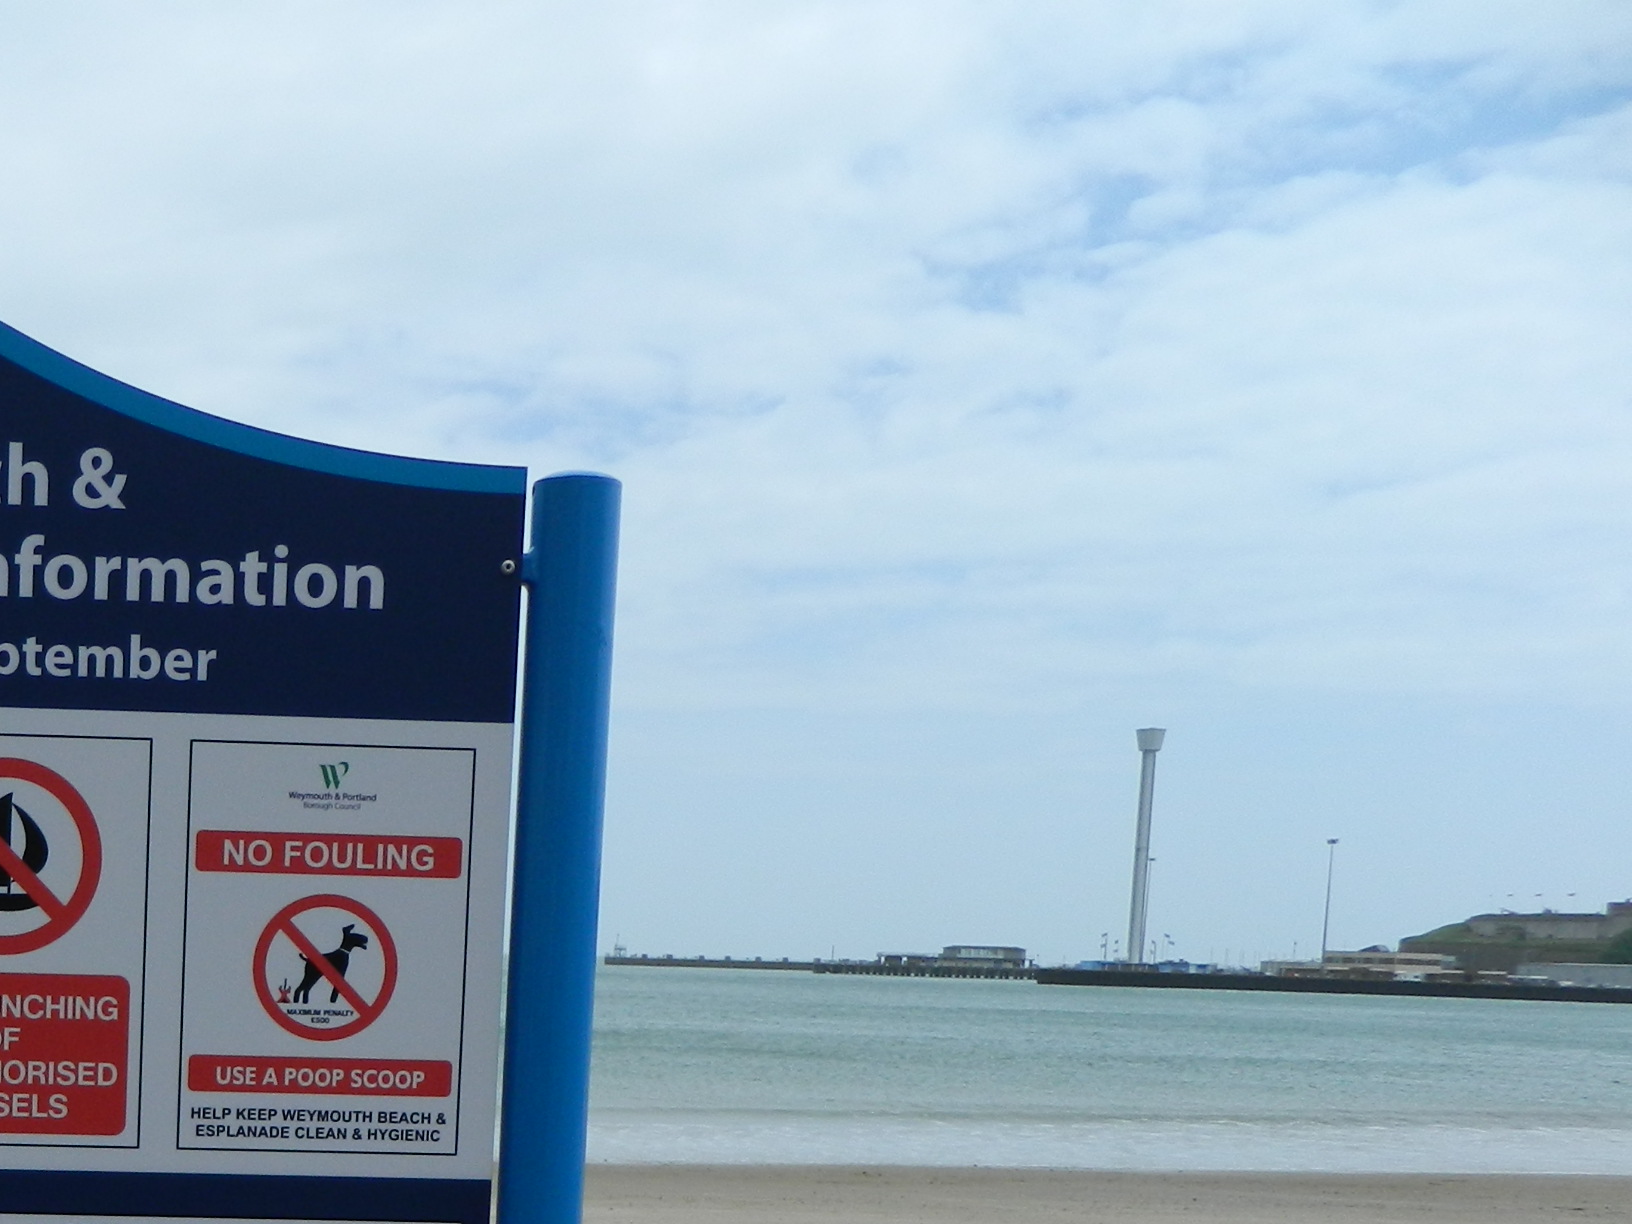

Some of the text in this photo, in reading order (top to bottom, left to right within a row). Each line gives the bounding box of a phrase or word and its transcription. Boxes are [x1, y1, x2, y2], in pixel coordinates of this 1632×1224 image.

[72, 447, 127, 509] &
[289, 791, 377, 803] Weymouth & Portland
[223, 839, 434, 871] NO FOULING
[216, 1066, 424, 1089] USE A POOP SCOOP
[190, 1106, 446, 1125] HELP KEEP WEYMOUTH BEACH &
[195, 1124, 440, 1142] ESPLANADE CLEAN & HYGIENIC
